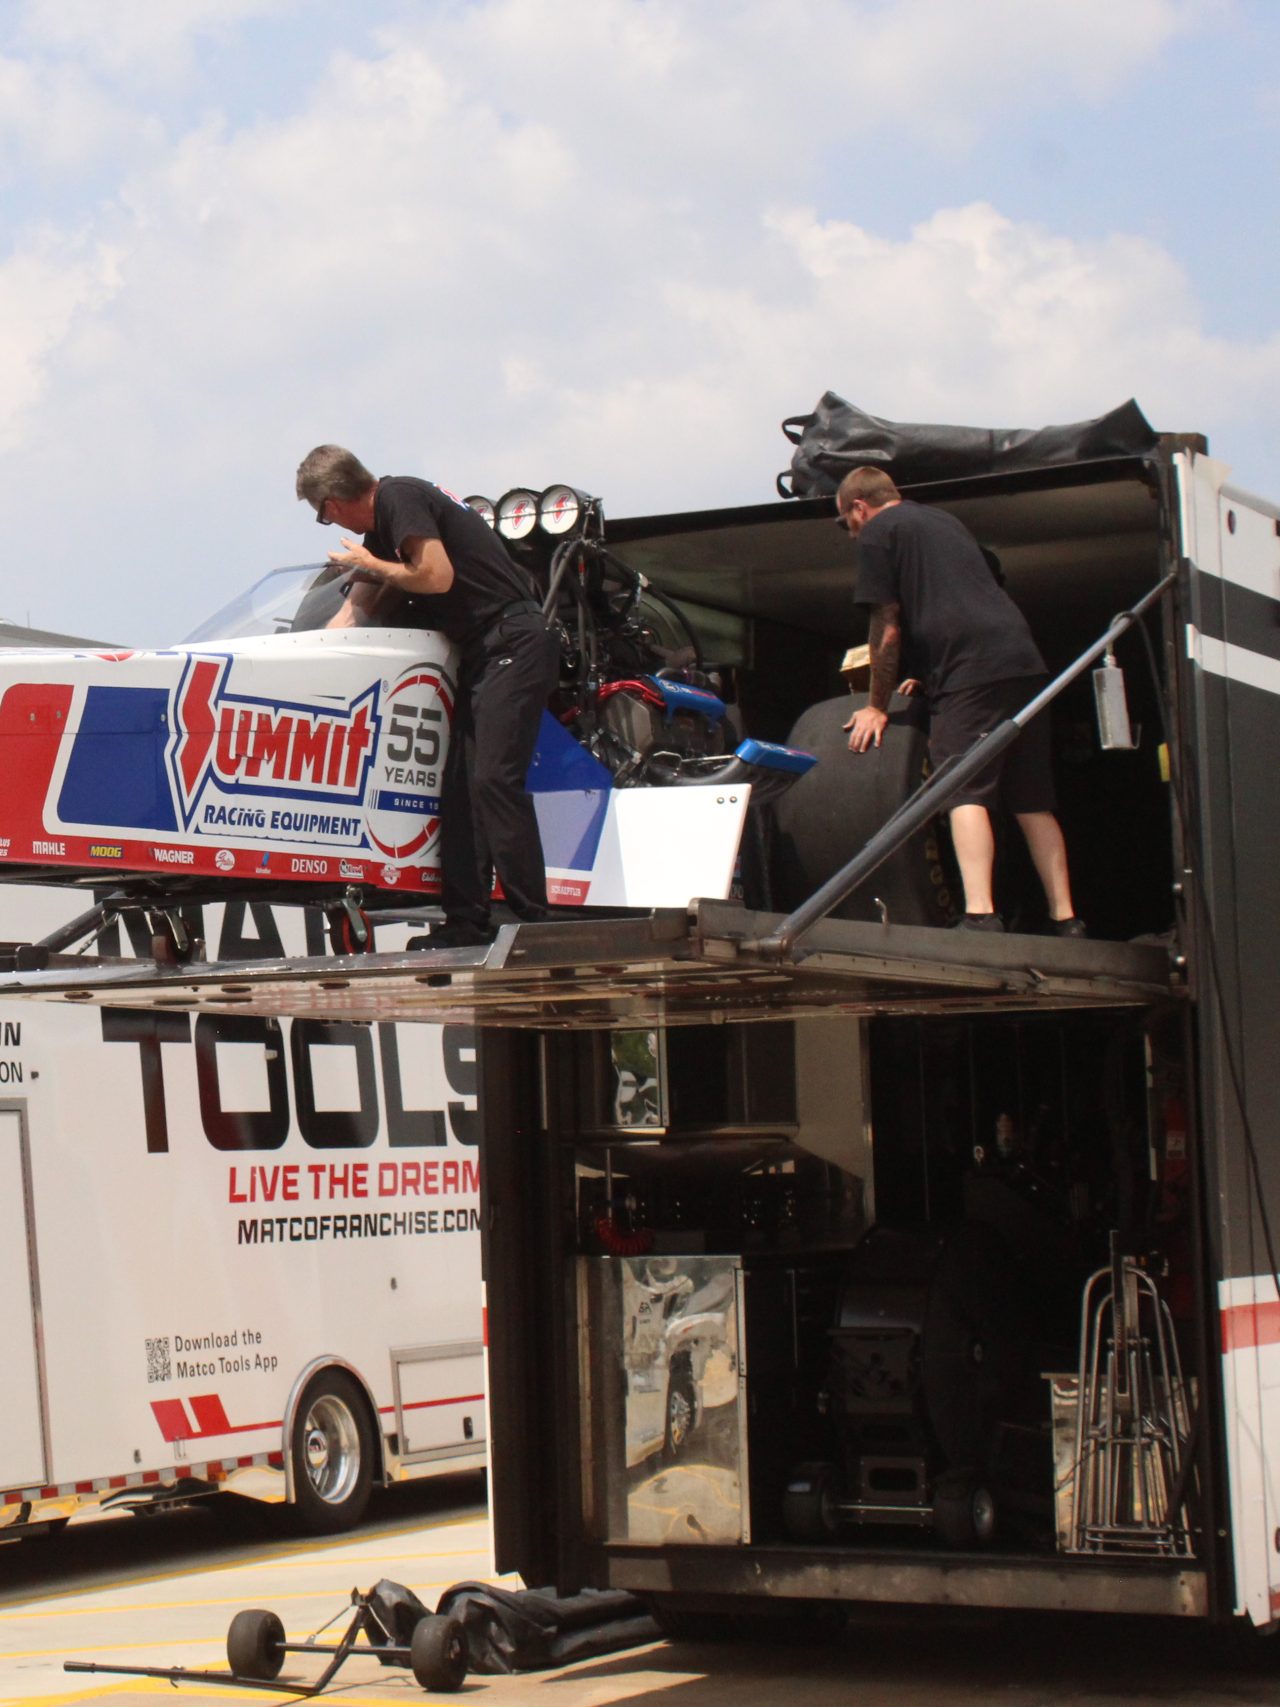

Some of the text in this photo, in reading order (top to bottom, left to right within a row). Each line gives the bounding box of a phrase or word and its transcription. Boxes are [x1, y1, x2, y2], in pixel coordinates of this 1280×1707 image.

[386, 703, 443, 767] 55
[384, 766, 437, 788] YEARS
[393, 798, 425, 809] SINCE
[203, 804, 362, 838] RACING EQUIPMENT
[32, 840, 66, 856] MAHLE
[89, 845, 123, 858] MOOG
[153, 847, 195, 865] WAGNER
[291, 858, 328, 875] DENSO
[228, 1164, 300, 1204] LIVE
[307, 1163, 369, 1200] THE
[174, 1327, 263, 1353] Download the
[177, 1353, 279, 1380] Matco Tools App
